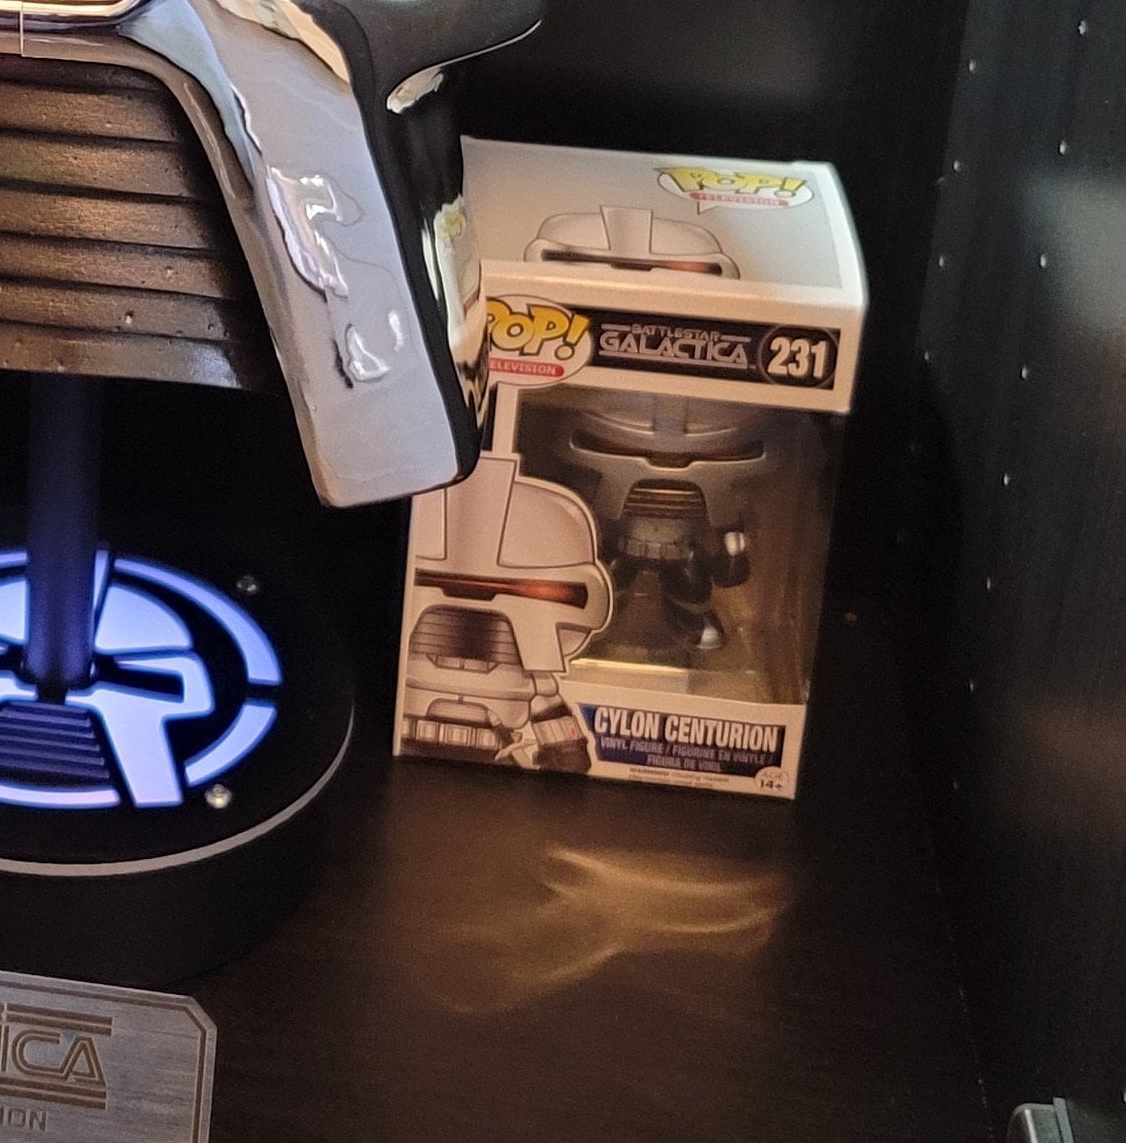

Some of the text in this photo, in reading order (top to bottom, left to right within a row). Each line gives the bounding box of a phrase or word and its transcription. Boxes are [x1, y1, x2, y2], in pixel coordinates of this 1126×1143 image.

[659, 167, 807, 198] POP!
[631, 323, 720, 342] BATTLESTAR
[599, 331, 749, 363] GALACTICA
[767, 336, 827, 379] 231
[490, 361, 557, 376] ELEVISION
[594, 706, 779, 753] CYLON CENTURION
[600, 736, 628, 750] VINYL
[630, 740, 663, 754] FIGURE
[673, 744, 716, 760] FIGURINE
[760, 778, 784, 791] 14+
